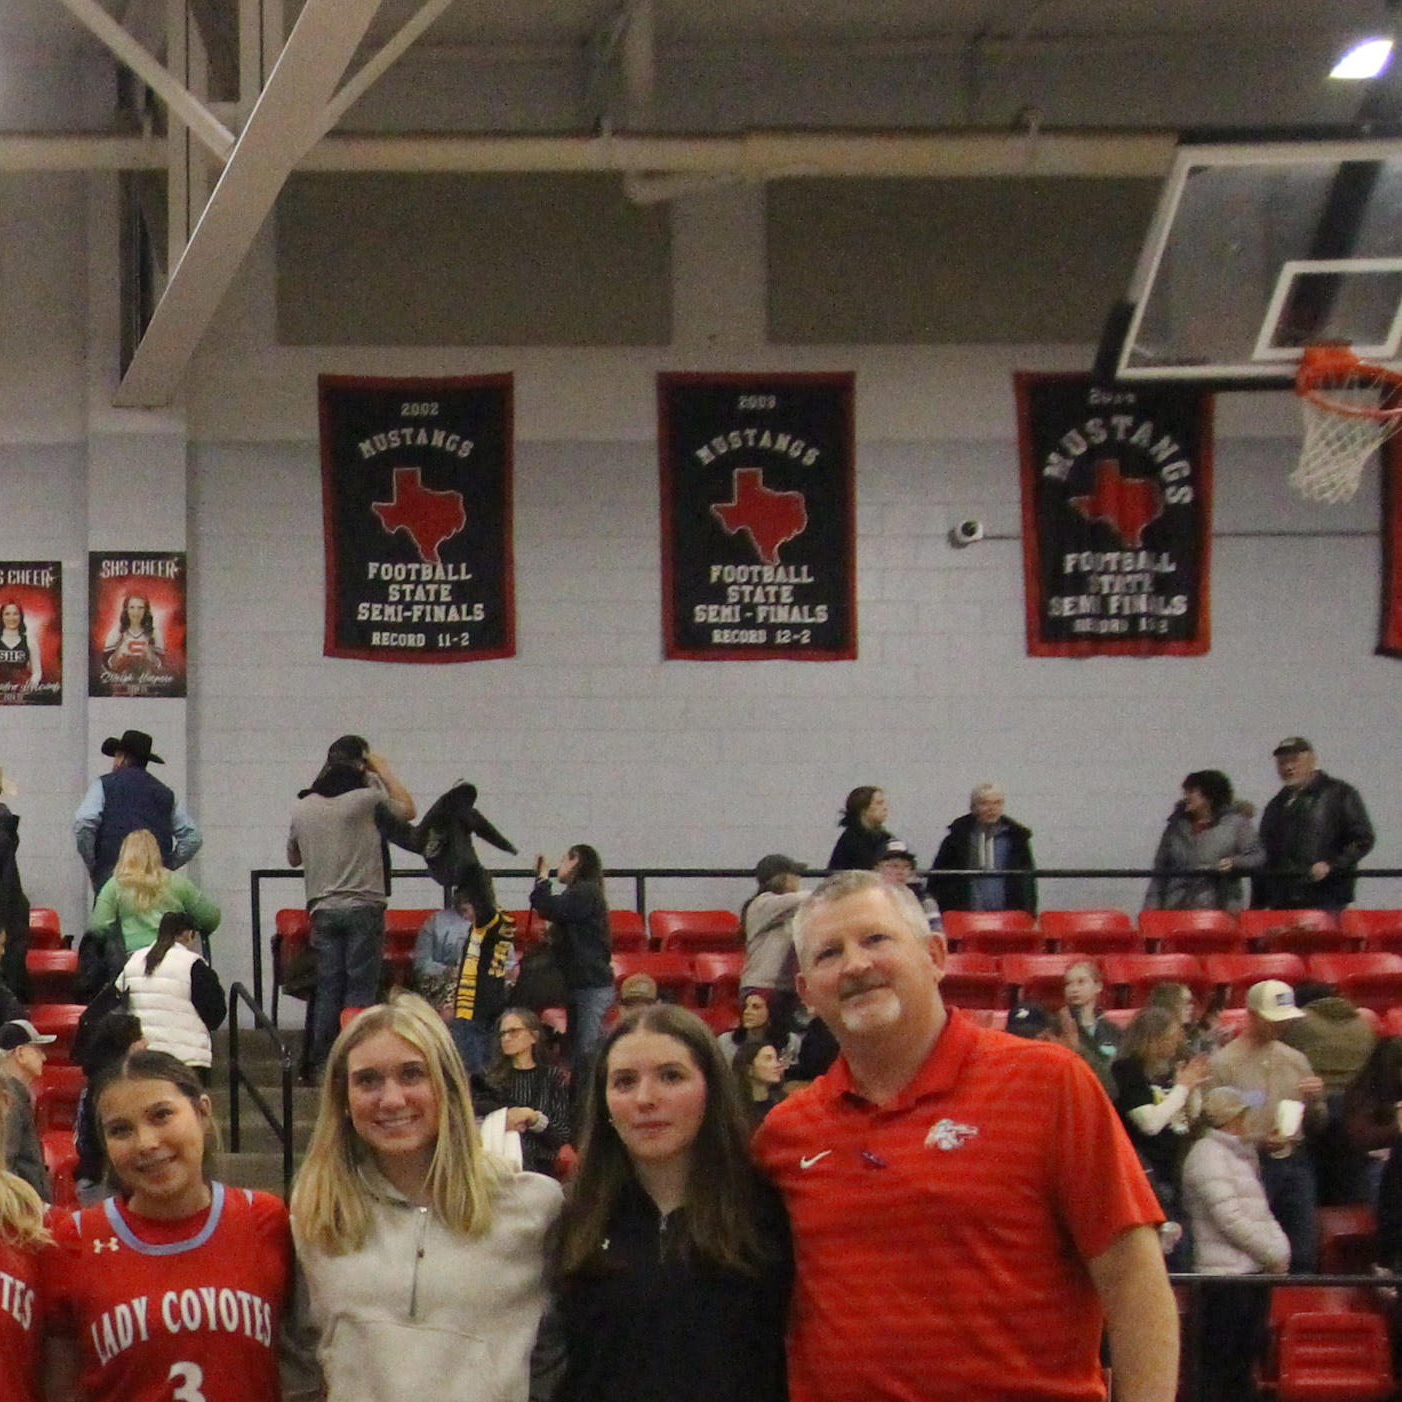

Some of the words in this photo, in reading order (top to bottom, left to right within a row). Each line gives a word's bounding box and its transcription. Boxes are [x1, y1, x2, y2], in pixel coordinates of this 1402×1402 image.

[358, 428, 474, 459] MUSTANGS
[695, 428, 820, 466] MUSTANGS
[1043, 415, 1194, 504] MUSTANGS
[100, 560, 128, 578] SHS
[132, 560, 175, 579] CHEER
[368, 562, 472, 580] FOOTBALL
[710, 565, 814, 583] FOOTBALL
[8, 570, 50, 588] CHEER
[388, 584, 452, 601] STATE
[726, 585, 794, 603] STATE
[357, 602, 485, 623] SEMI-FINALS
[371, 632, 425, 646] RECORD
[437, 632, 470, 646] 11-2
[712, 629, 766, 644] RECORD
[775, 629, 811, 644] 12-2
[91, 1297, 149, 1363] LADY
[161, 1289, 272, 1346] COYOTES
